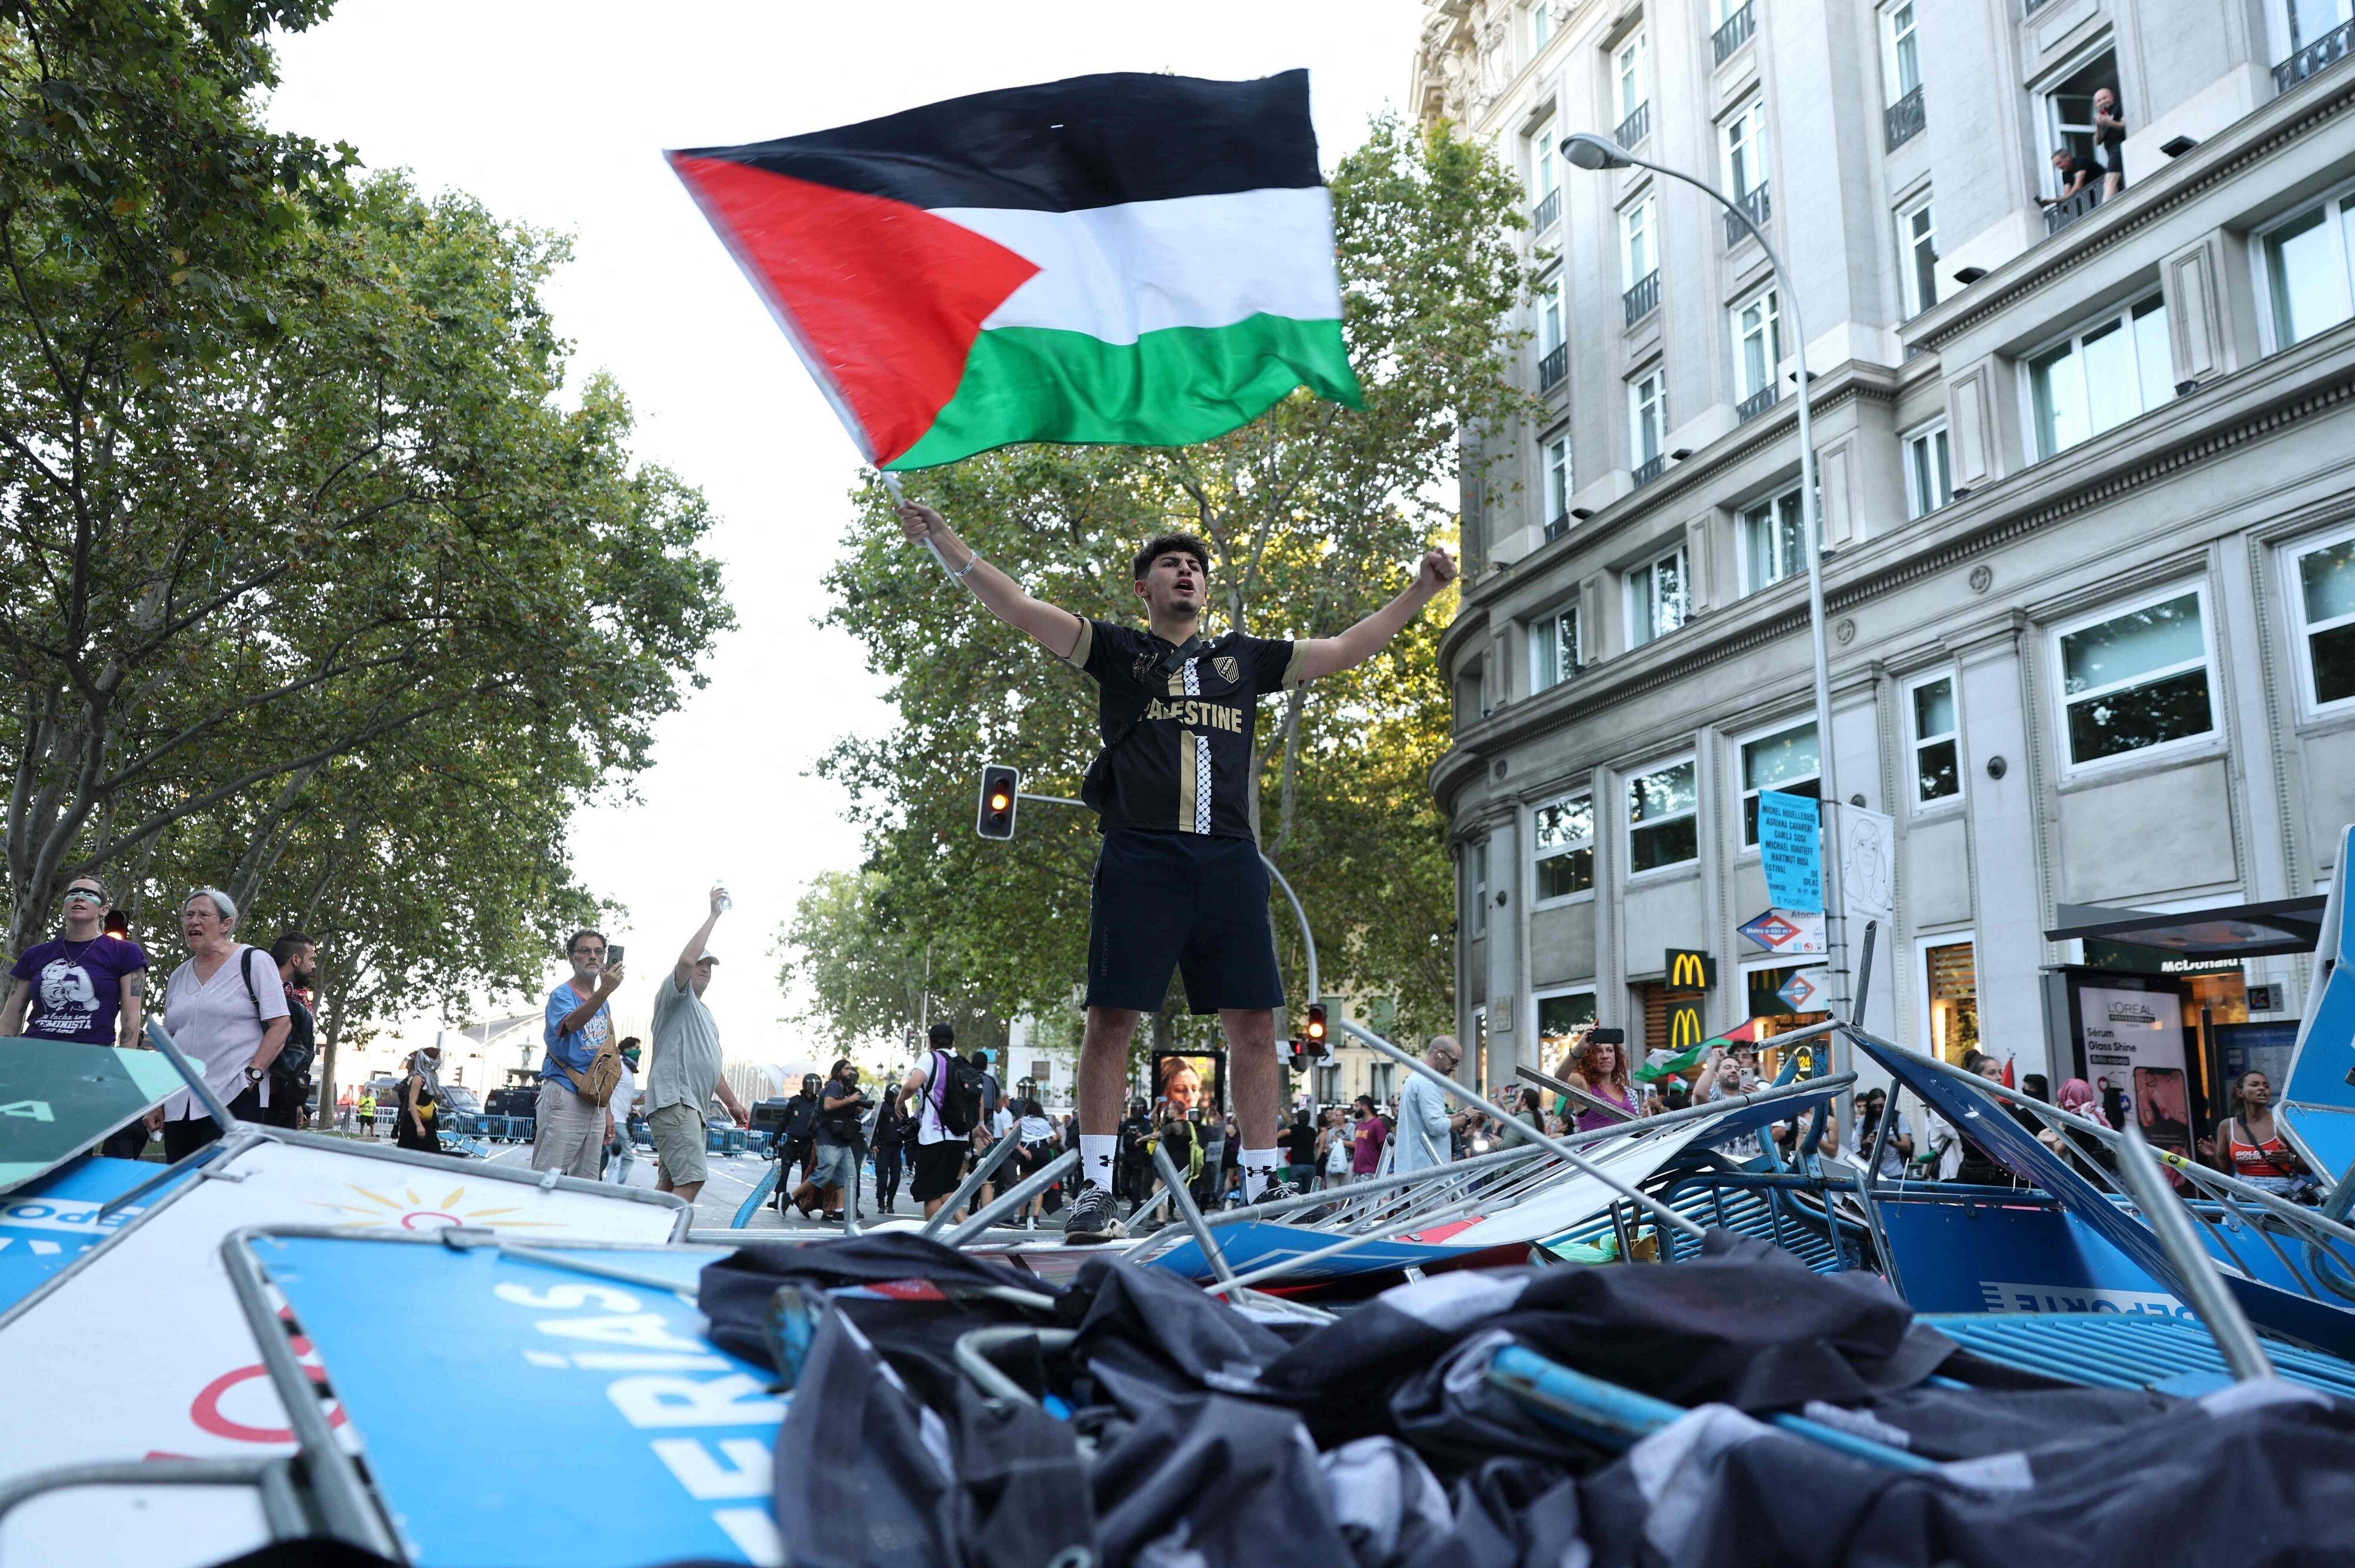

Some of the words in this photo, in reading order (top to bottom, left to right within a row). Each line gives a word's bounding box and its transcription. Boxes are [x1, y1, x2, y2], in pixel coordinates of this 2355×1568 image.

[1763, 805, 1781, 816] MICHEL
[1766, 817, 1788, 828] ADRIANA
[1774, 830, 1793, 841] CAMILA
[1794, 834, 1806, 842] SOSA
[1766, 841, 1790, 852] MICHAEL
[1771, 852, 1796, 865] HARTMUT
[1797, 857, 1809, 866] ROSA
[1764, 863, 1786, 873] ESTIVAL
[1803, 878, 1819, 886] IDEAS
[2161, 957, 2246, 972] McDonalds
[2087, 1026, 2114, 1037] Sérum
[2088, 1041, 2112, 1051] Glass
[2113, 1042, 2137, 1052] Shine
[1800, 1056, 1811, 1068] 24
